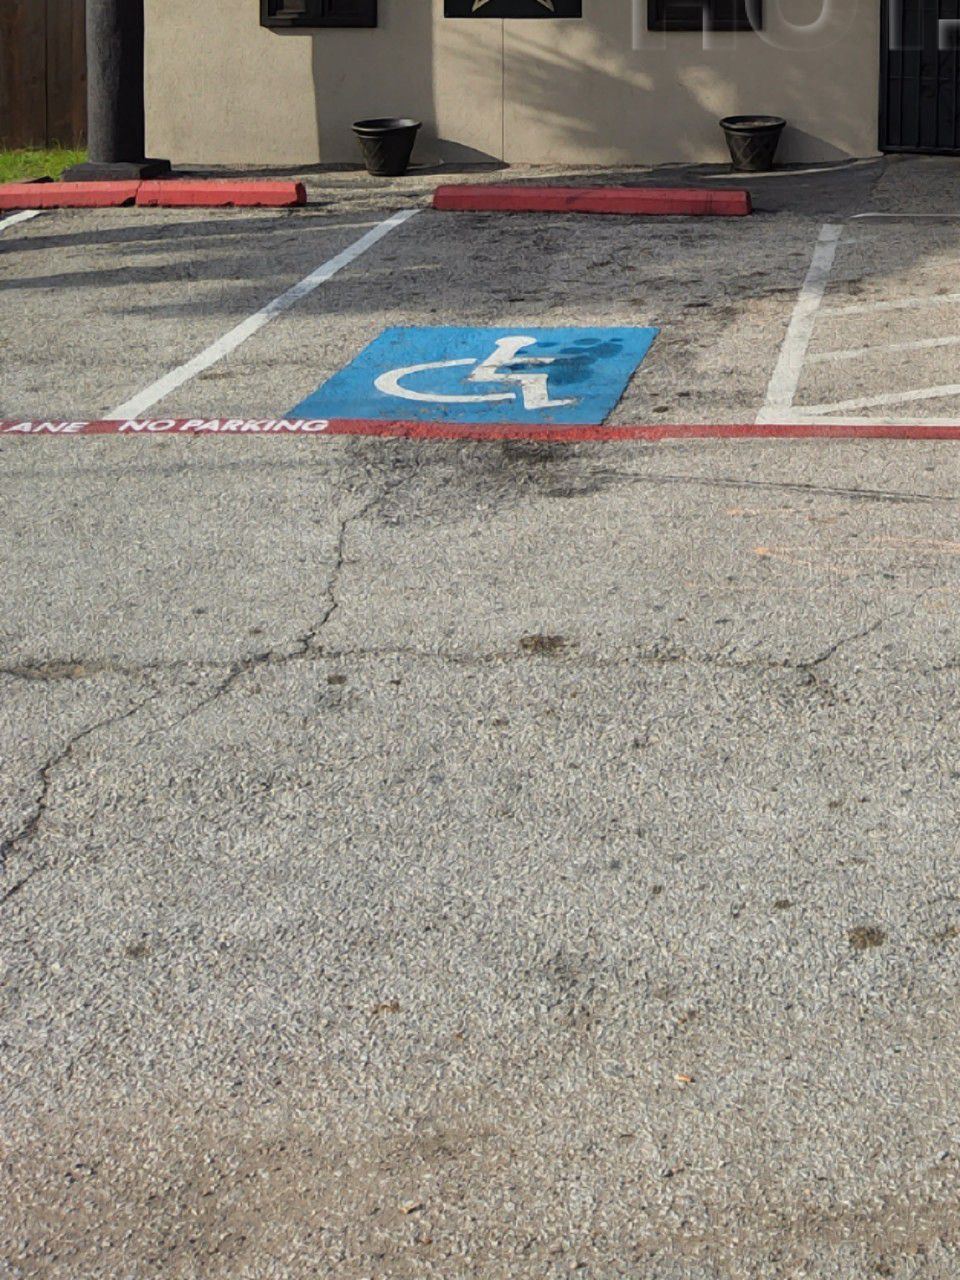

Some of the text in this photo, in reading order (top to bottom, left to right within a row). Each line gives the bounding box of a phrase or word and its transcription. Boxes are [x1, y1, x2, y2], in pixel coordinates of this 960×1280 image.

[0, 420, 330, 433] ANE NO PARKING
